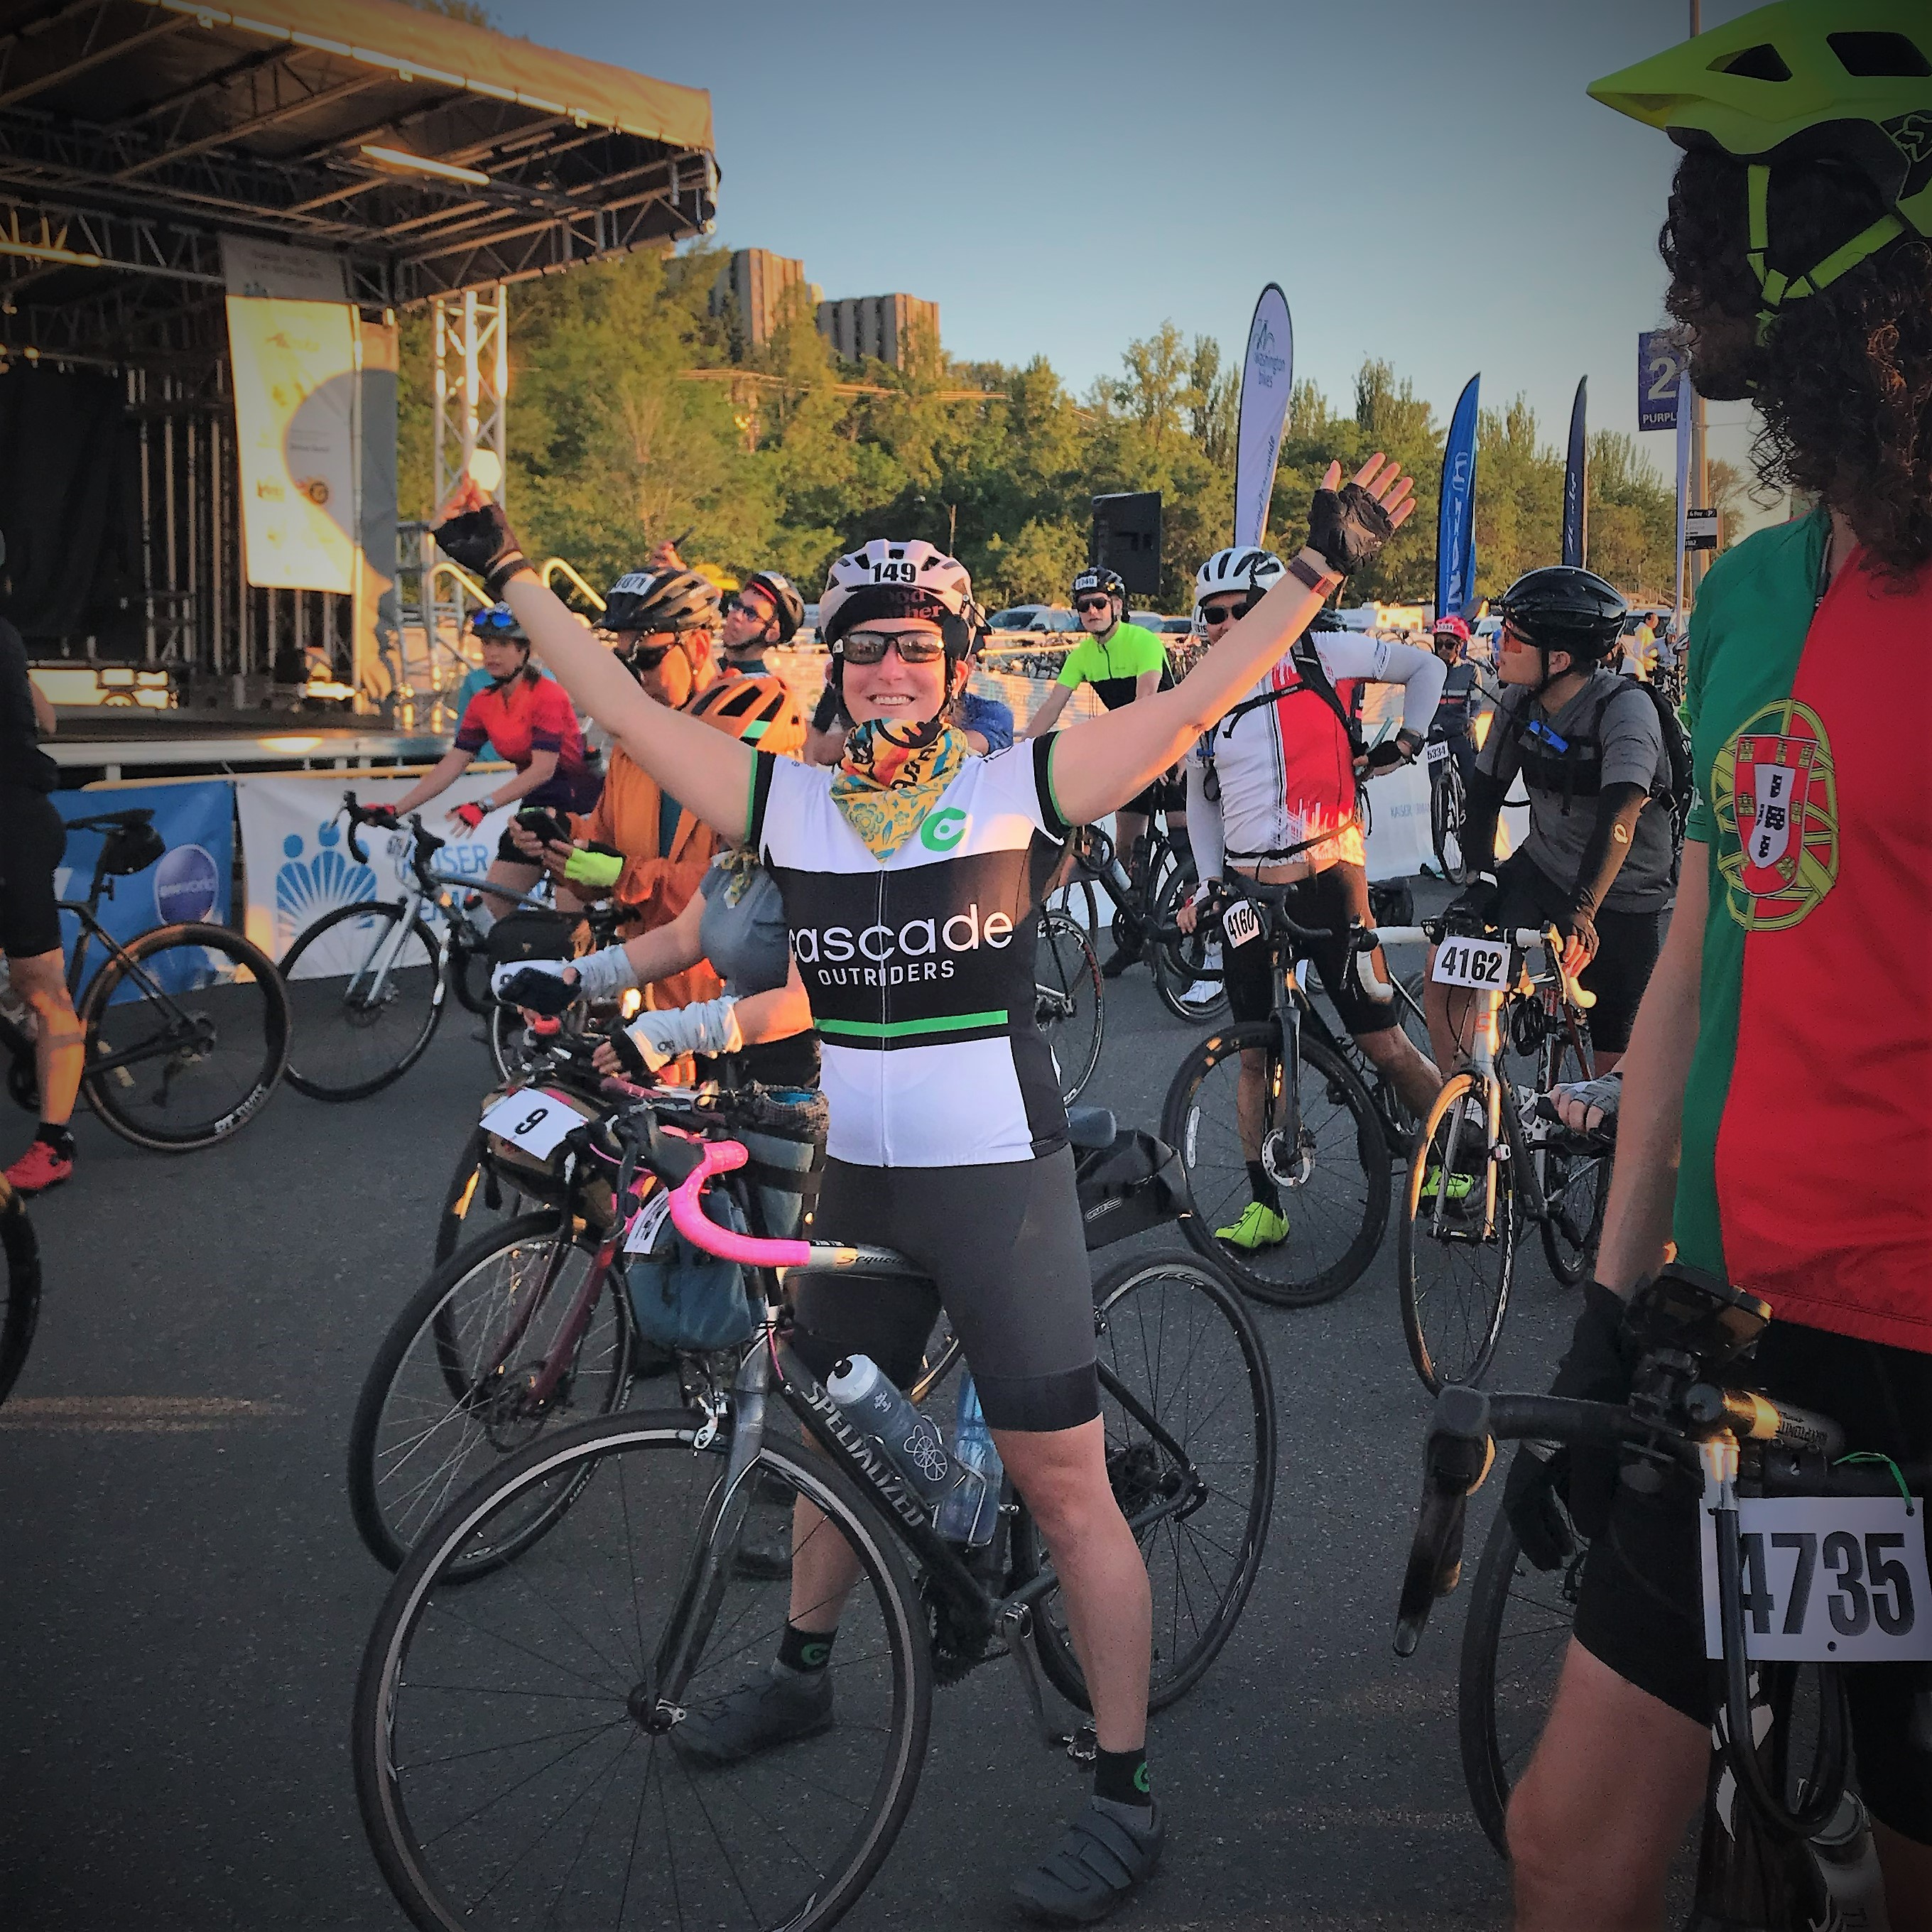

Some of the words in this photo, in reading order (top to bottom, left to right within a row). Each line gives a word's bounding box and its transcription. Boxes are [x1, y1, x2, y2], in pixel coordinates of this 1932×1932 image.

[1648, 356, 1677, 399] 2
[1642, 413, 1677, 424] PURPL
[872, 563, 916, 583] 149
[788, 903, 1014, 963] cascade
[1227, 908, 1254, 939] 4160
[818, 960, 955, 987] OUTRIDERS
[1441, 946, 1502, 983] 4162
[514, 1108, 549, 1135] 9
[802, 1381, 925, 1527] SPECIALIZED
[1740, 1531, 1915, 1637] 4735
